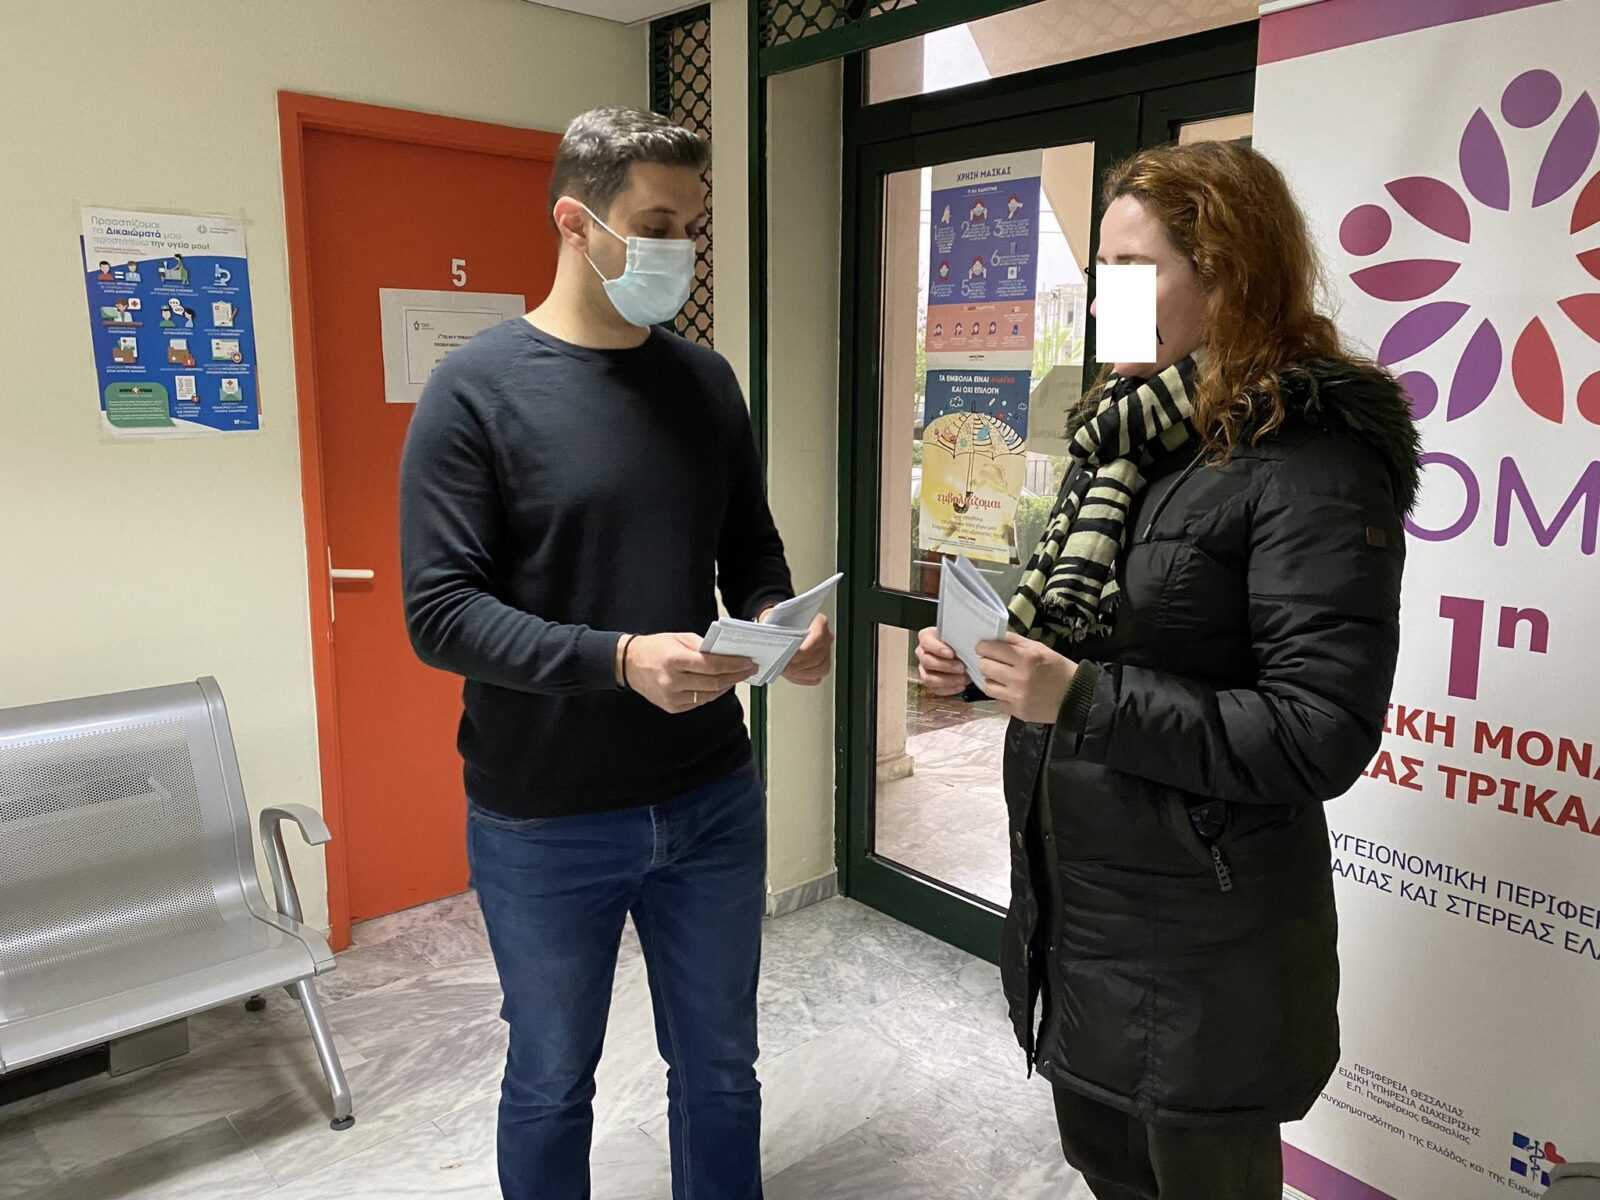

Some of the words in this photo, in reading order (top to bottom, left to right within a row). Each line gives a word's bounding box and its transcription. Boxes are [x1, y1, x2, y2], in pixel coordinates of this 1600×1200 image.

[451, 258, 467, 287] 5
[1361, 751, 1424, 791] ΑΣ
[1474, 720, 1600, 781] ΜΟΝ
[1331, 830, 1486, 894] ΥΓΕΙΟΝΟΜΙΚΗ
[1497, 880, 1600, 930] ΠΕΡΙΦΕ
[1400, 880, 1438, 908] ΚΑΙ
[1446, 894, 1555, 945] ΣΤΕΡΕΑΣ
[1564, 930, 1600, 961] ΕΛ
[1339, 1066, 1369, 1087] ΕΙΔΙΚΗ
[1371, 1081, 1417, 1108] ΥΠΗΡΕΣΙΑ
[1419, 1104, 1481, 1137] ΔΙΑΧΕΙΡΙΣΗΣ
[1354, 1063, 1408, 1094] ΠΕΡΙΦΕΡΕΙΑ
[1410, 1088, 1464, 1119] ΘΕΣΣΑΛΙΑΣ
[1408, 1133, 1424, 1148] της
